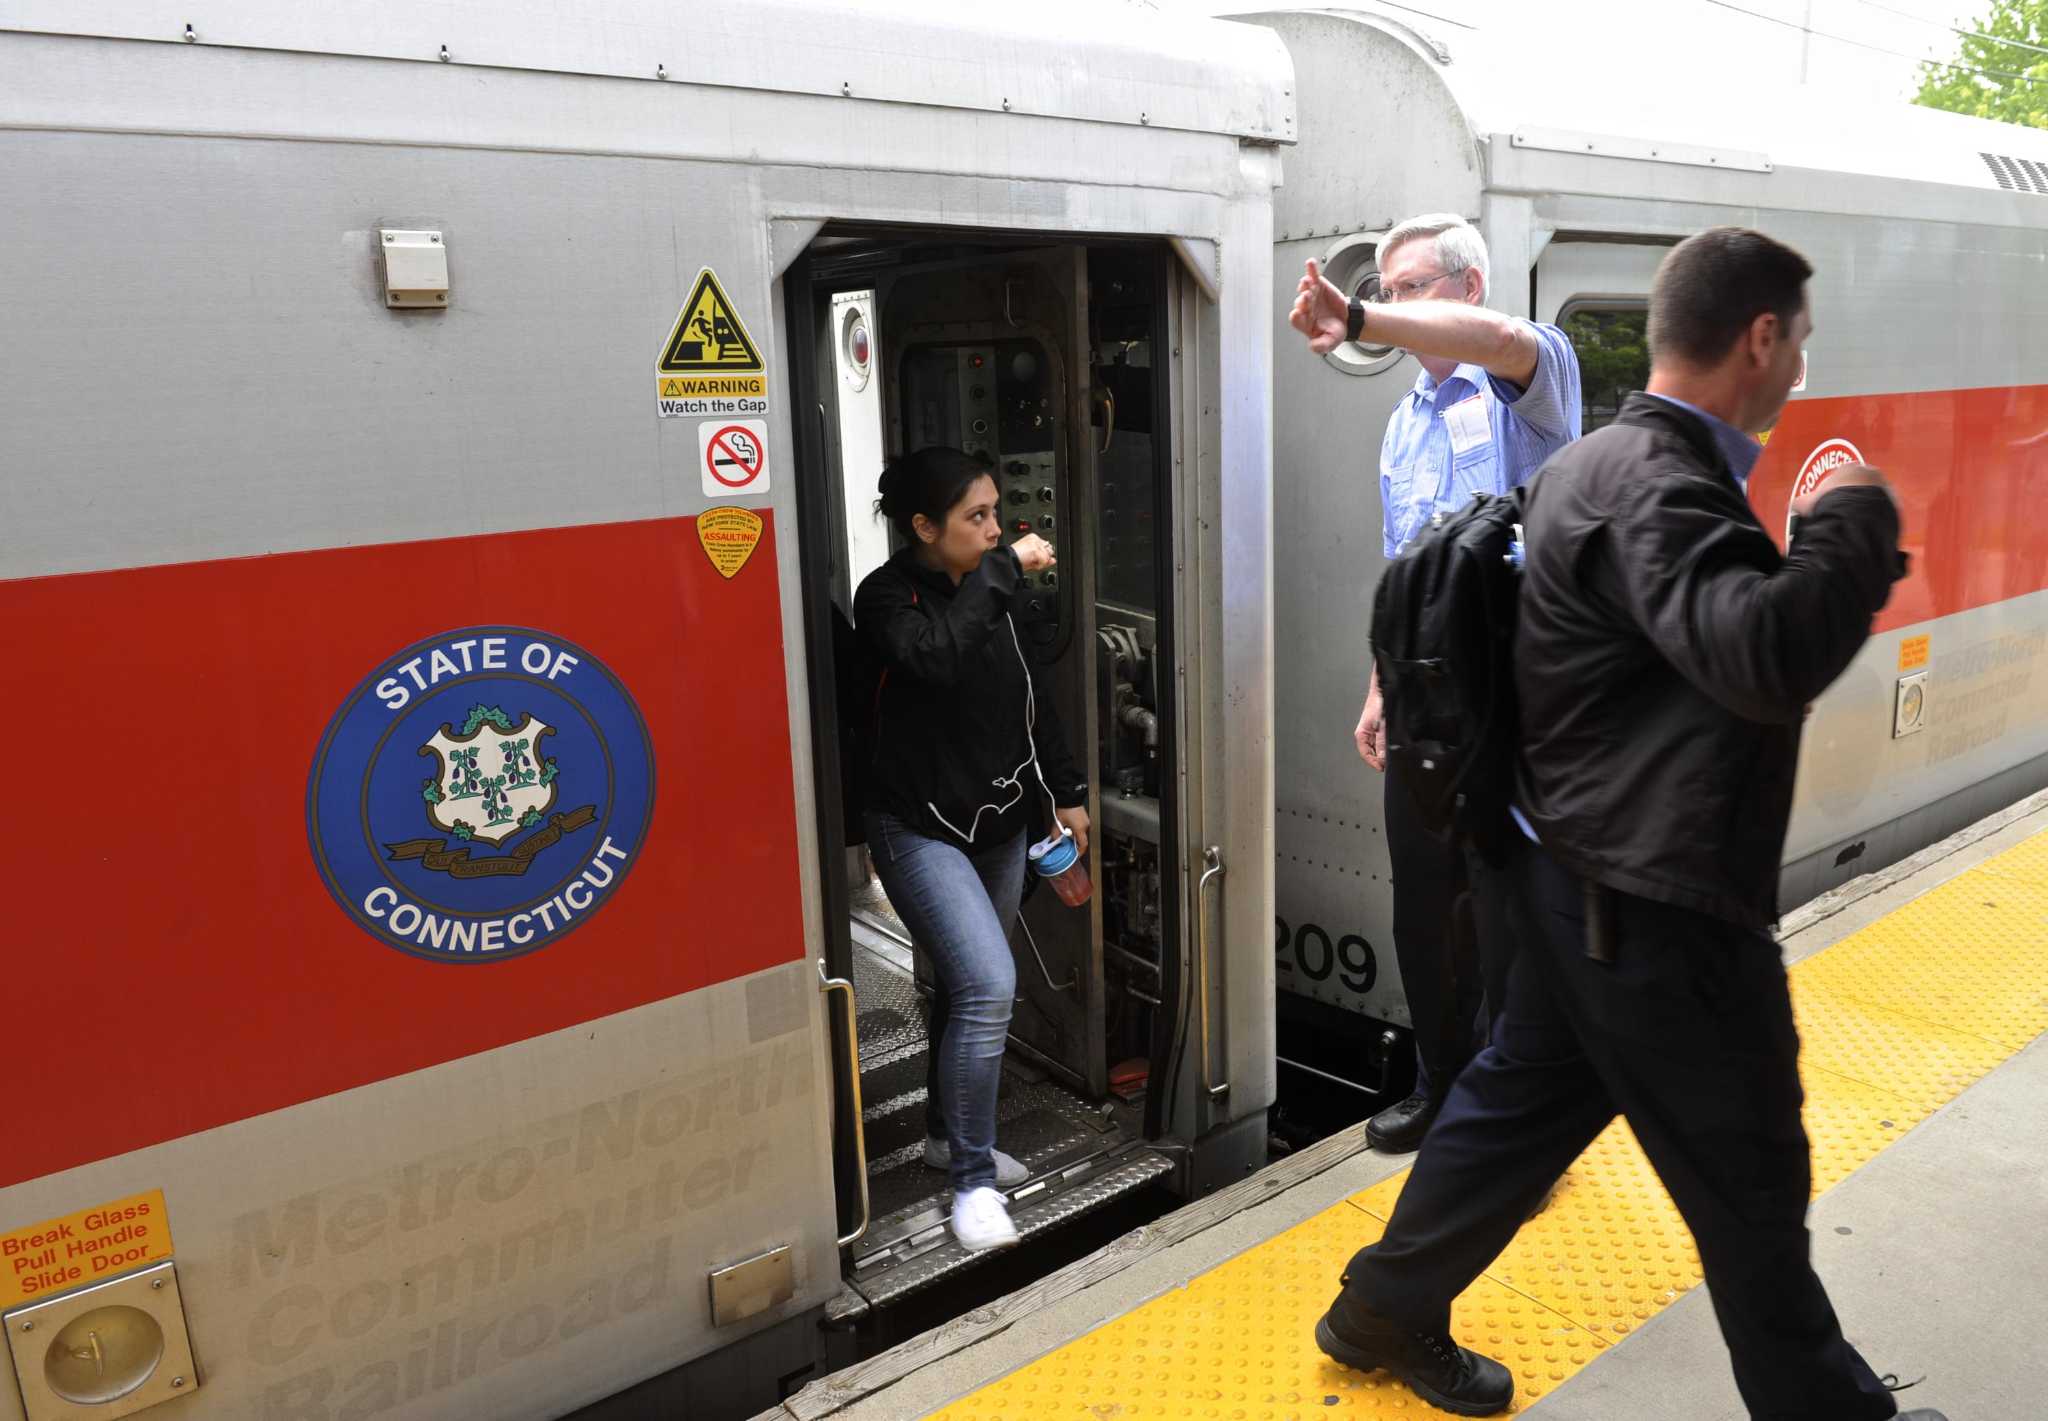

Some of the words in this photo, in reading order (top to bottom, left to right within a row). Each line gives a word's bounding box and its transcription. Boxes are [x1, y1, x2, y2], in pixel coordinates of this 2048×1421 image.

[660, 399, 708, 414] Watch
[711, 399, 735, 412] the
[737, 398, 767, 414] Gap
[681, 379, 760, 394] WARNING
[704, 533, 756, 542] ASSAULTING
[375, 638, 507, 710] STATE
[520, 643, 579, 681] OF
[363, 836, 628, 952] CONNECTICUT
[2, 1224, 74, 1257] Break
[84, 1203, 151, 1231] Glass
[13, 1249, 57, 1275] Pull
[67, 1225, 148, 1259] Handle
[247, 1139, 771, 1367] Commuter
[21, 1266, 82, 1294] Slide
[92, 1245, 149, 1273] Door
